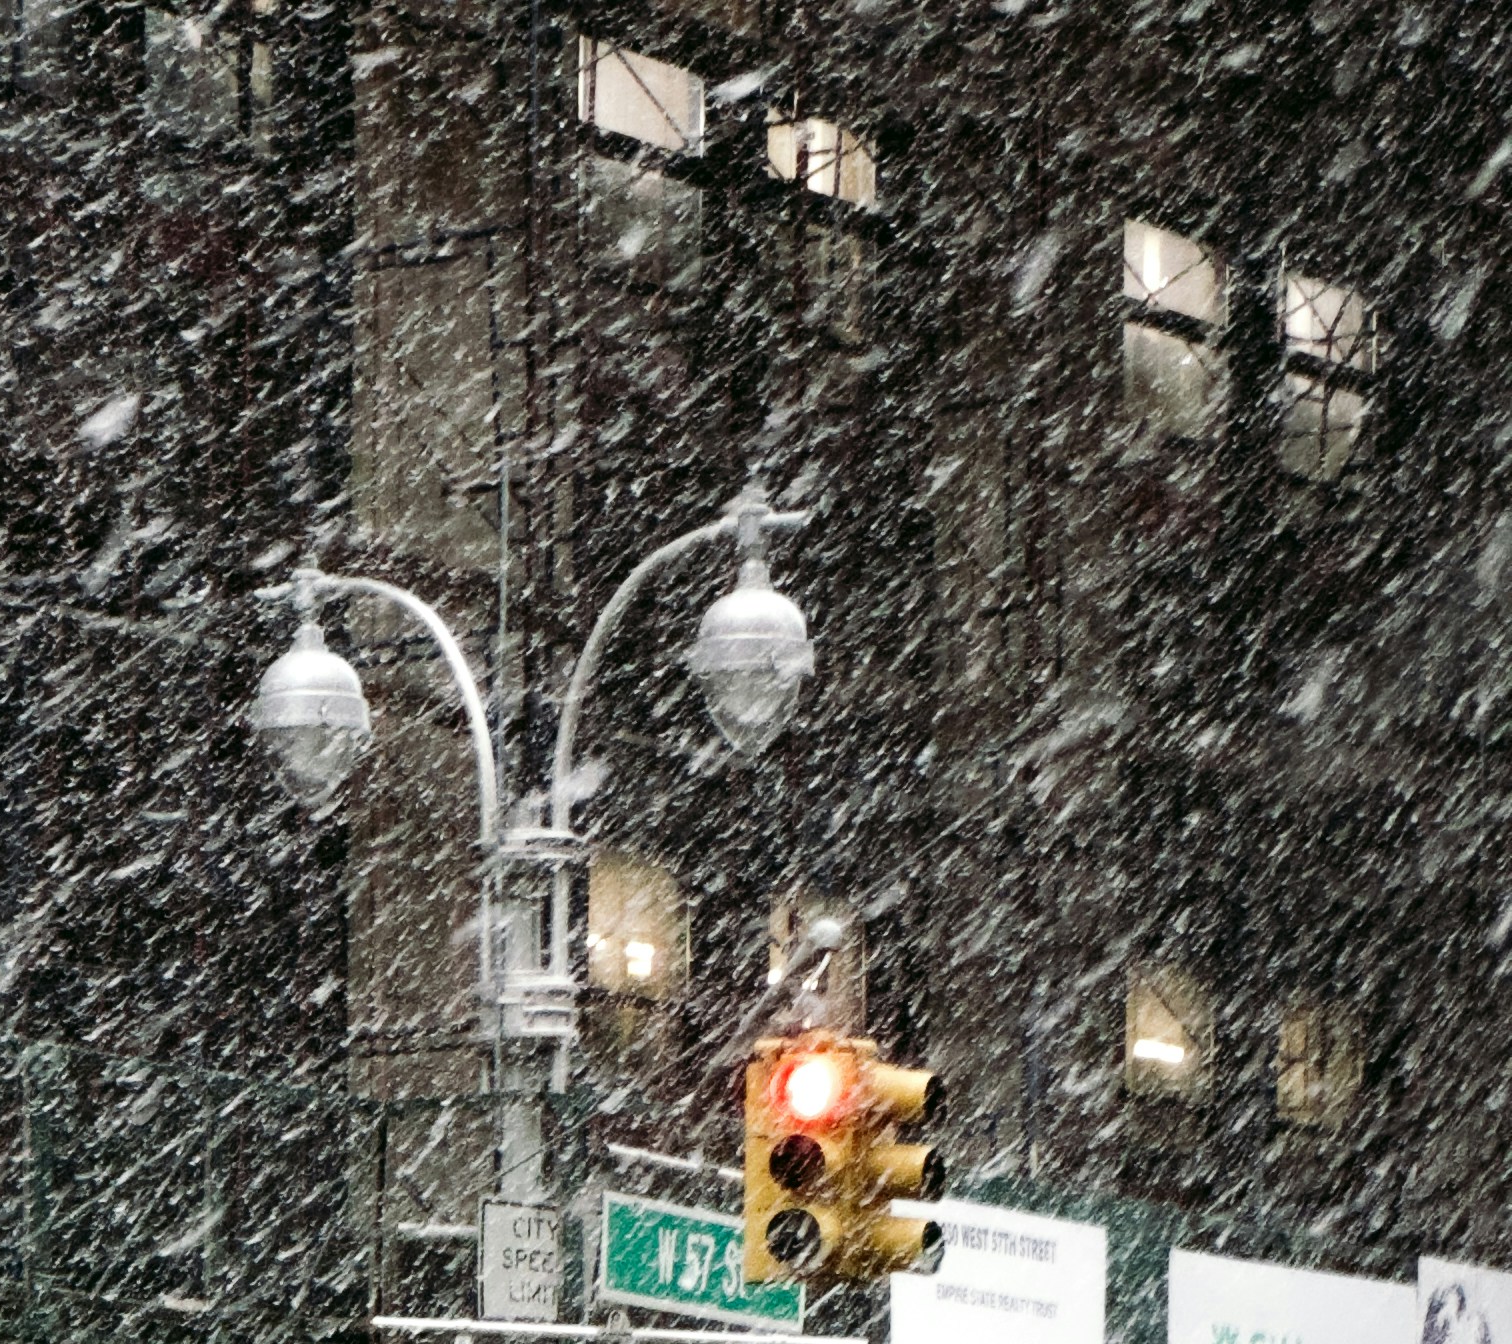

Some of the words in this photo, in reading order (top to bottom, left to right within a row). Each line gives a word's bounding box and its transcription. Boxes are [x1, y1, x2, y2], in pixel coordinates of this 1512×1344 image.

[513, 1216, 560, 1241] CITY
[961, 1225, 989, 1251] WEST
[1019, 1234, 1057, 1264] STREET
[502, 1247, 556, 1274] SPEE
[657, 1226, 679, 1286] W
[678, 1231, 717, 1297] 57
